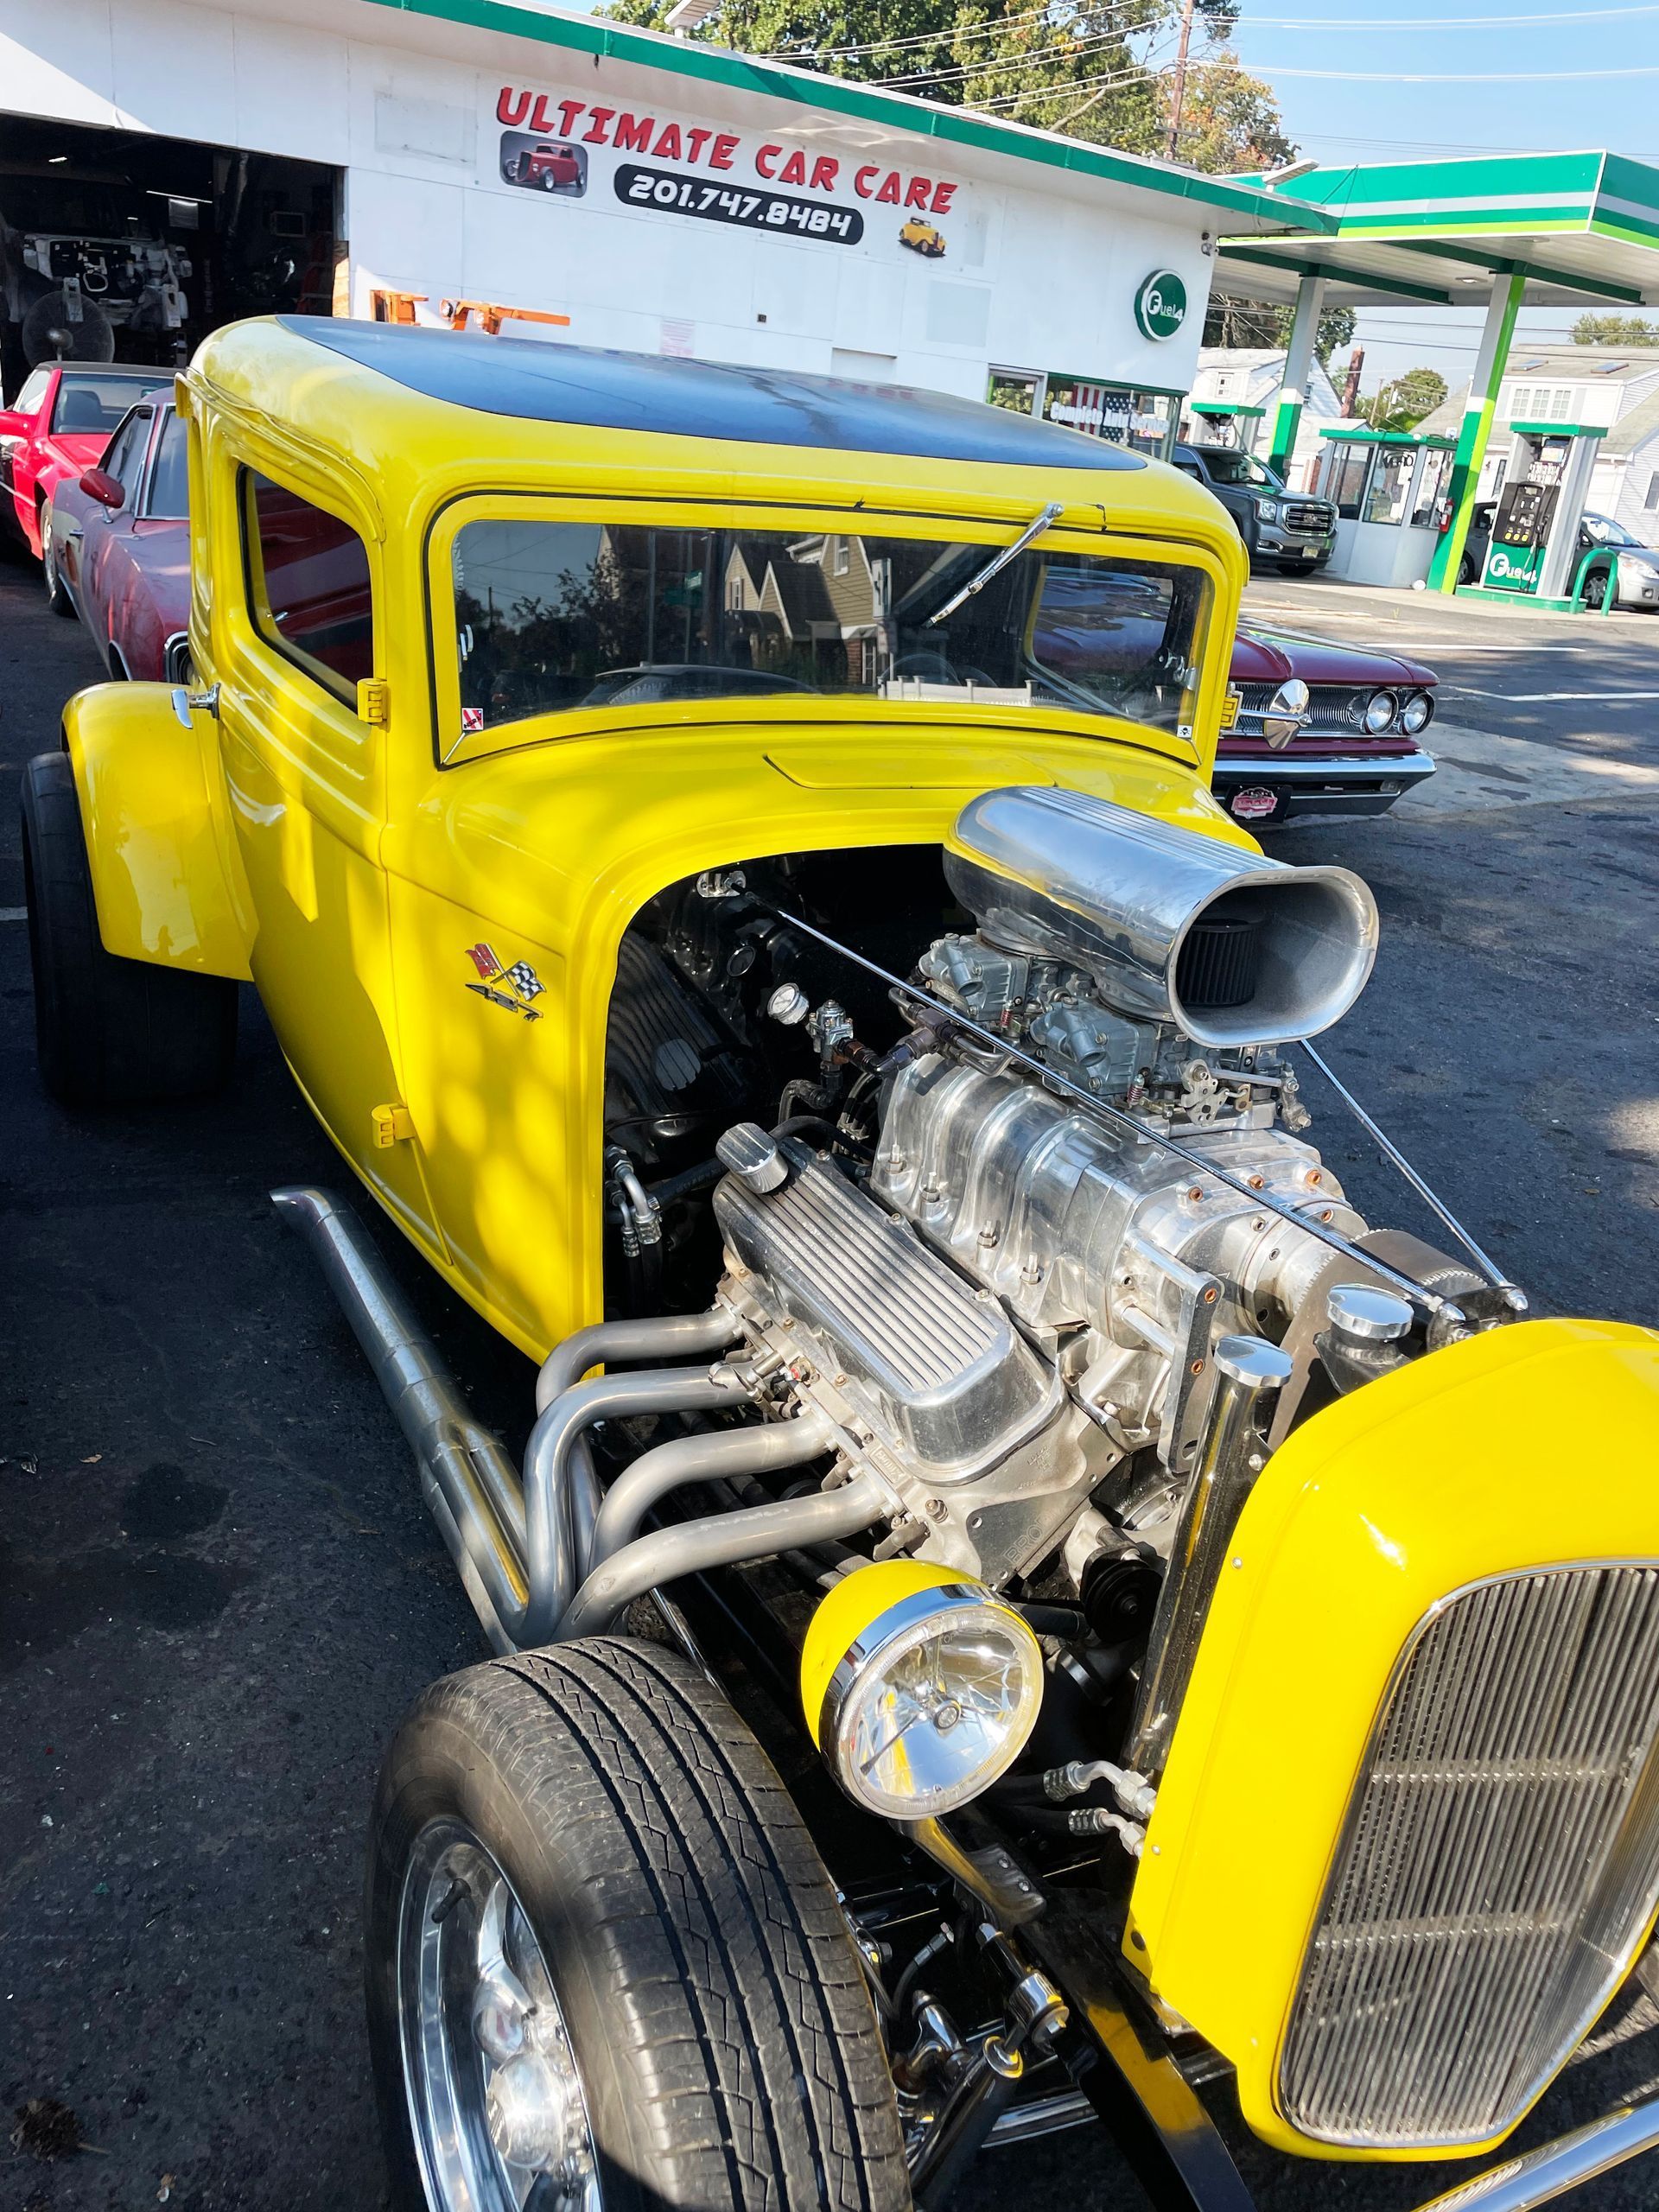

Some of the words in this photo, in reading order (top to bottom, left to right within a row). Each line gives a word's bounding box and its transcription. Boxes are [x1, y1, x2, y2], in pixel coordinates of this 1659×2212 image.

[496, 86, 741, 170] ULTIMATE
[755, 144, 839, 192] CAR
[855, 165, 958, 214] CARE
[628, 175, 852, 237] 201.747.8484
[1050, 400, 1103, 425] Complete
[1103, 407, 1129, 428] Auto
